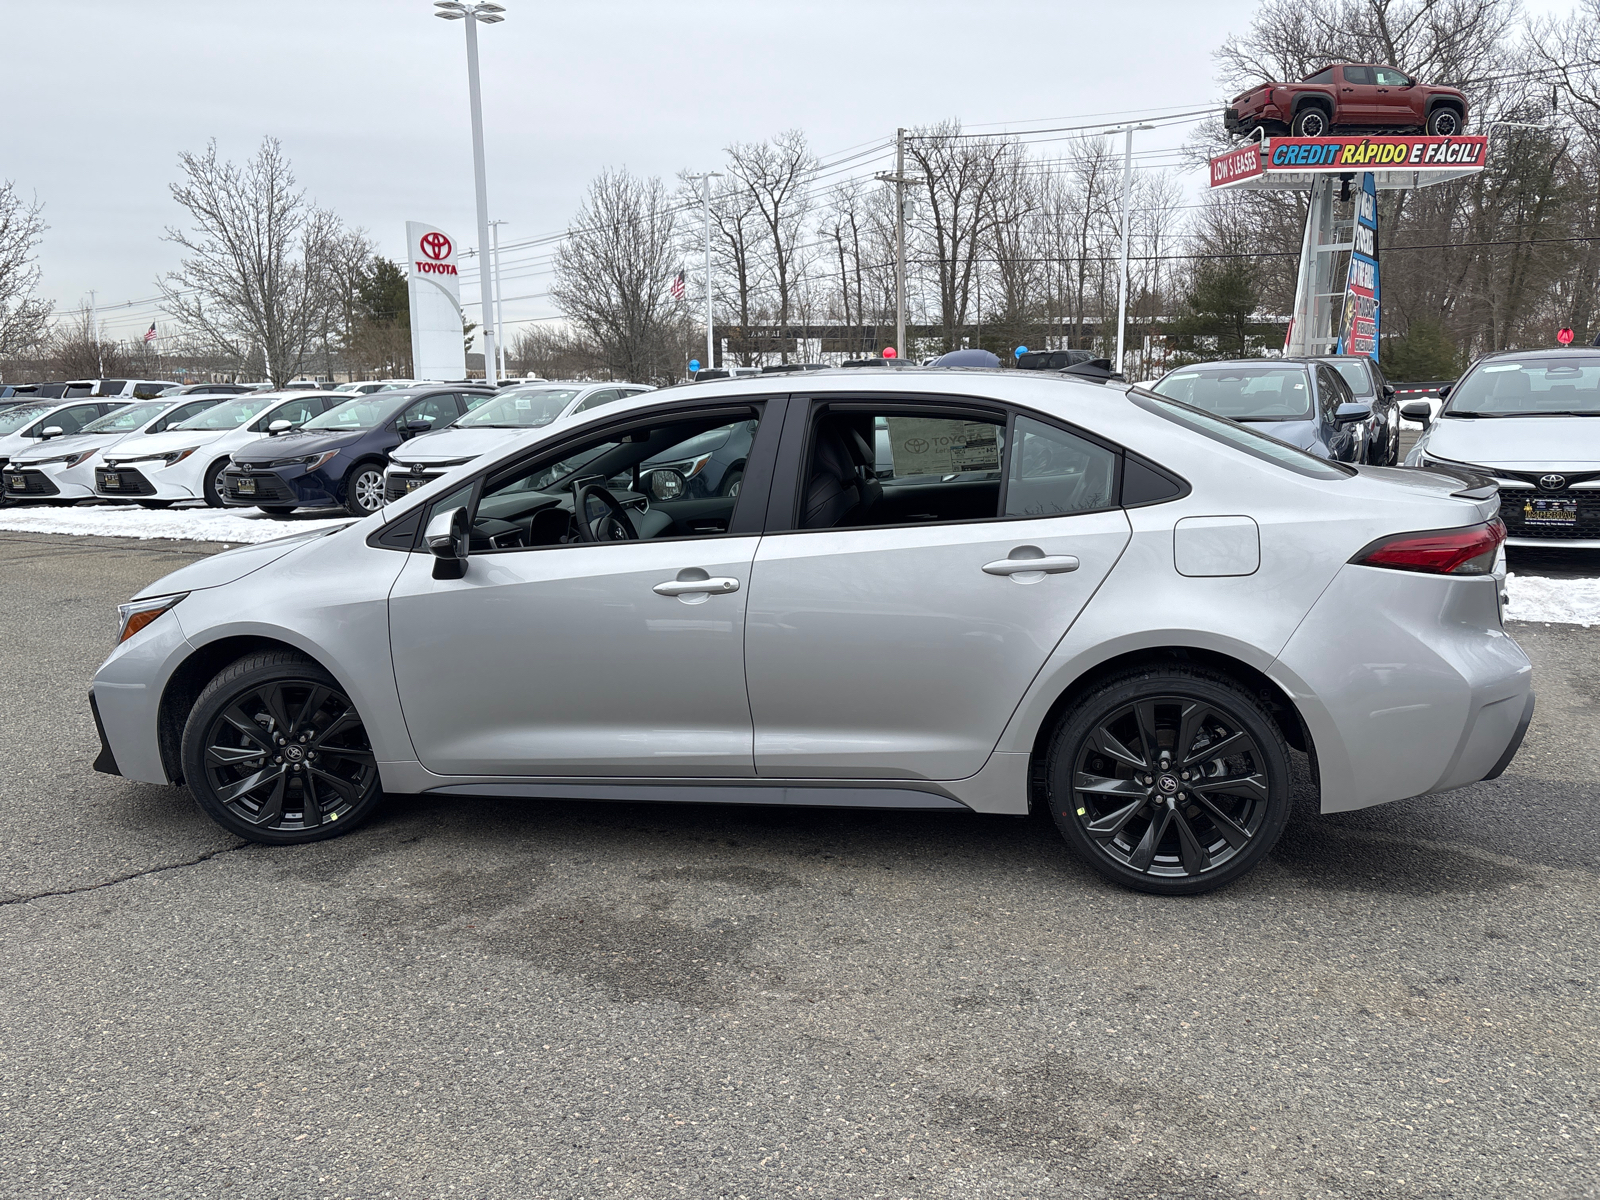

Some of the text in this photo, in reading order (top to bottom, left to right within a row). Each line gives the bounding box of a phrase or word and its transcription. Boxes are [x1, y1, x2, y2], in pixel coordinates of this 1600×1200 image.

[1272, 139, 1481, 165] CREDIT RÁPIDO E FÁCIL!
[1214, 160, 1228, 180] LOW
[1233, 150, 1257, 175] LEASES
[415, 261, 458, 276] TOYOTA
[931, 433, 982, 447] TOYOTA
[1524, 510, 1577, 519] IMPERIAL
